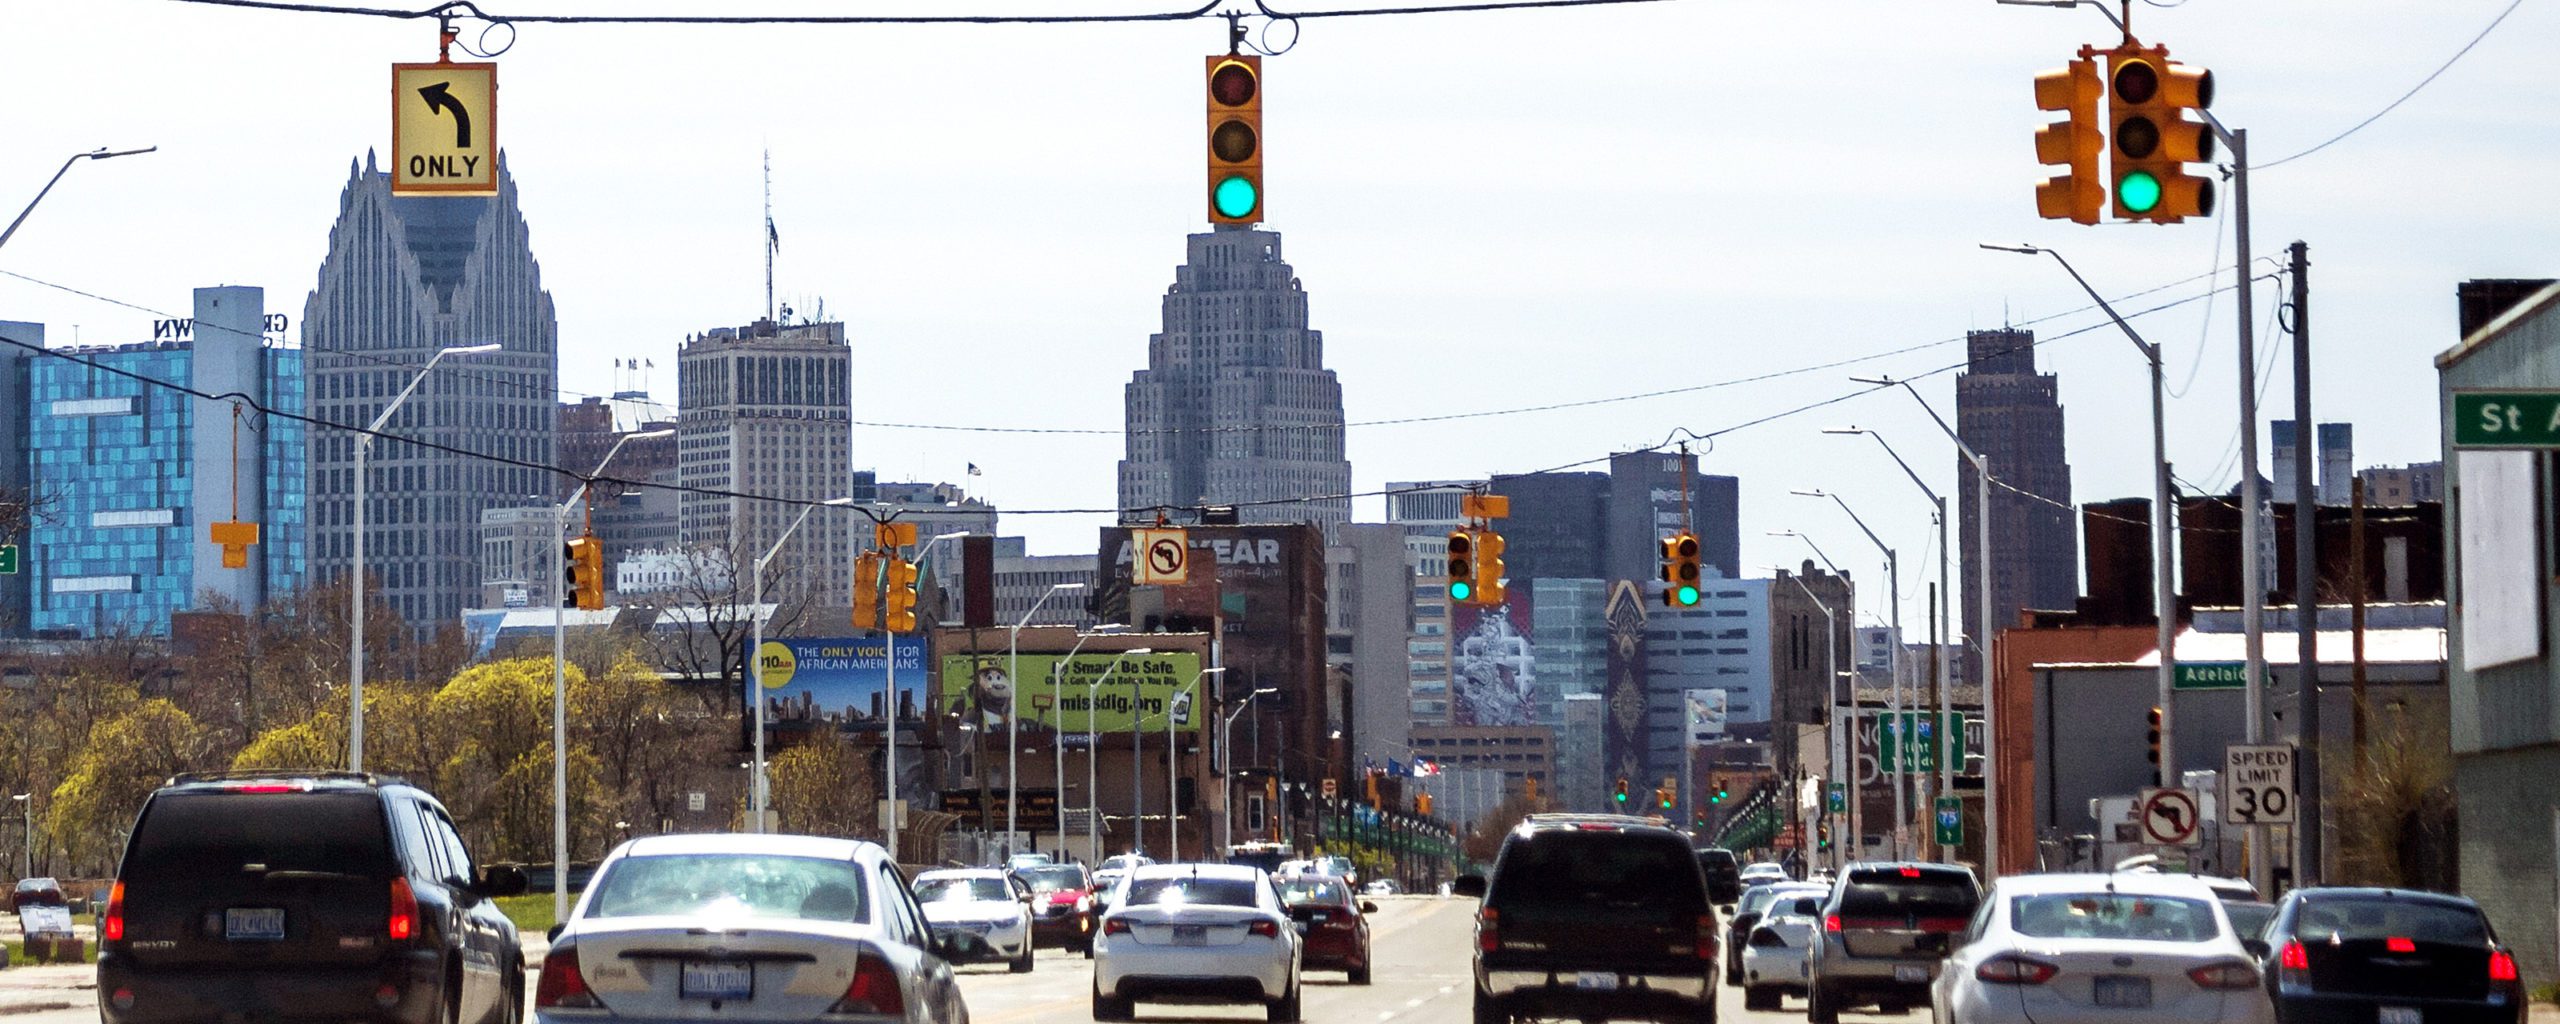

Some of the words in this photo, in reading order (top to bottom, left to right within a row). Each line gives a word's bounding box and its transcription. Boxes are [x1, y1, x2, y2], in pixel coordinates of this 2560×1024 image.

[410, 154, 480, 178] ONLY
[2481, 402, 2521, 432] St
[797, 647, 822, 657] THE
[822, 646, 854, 658] ONLY
[857, 647, 887, 658] VOIC
[896, 647, 919, 657] FOR
[798, 659, 849, 670] AFRICAN
[852, 659, 919, 670] AMERIANS
[1121, 661, 1140, 674] Be
[1143, 661, 1176, 674] Safe.
[2186, 667, 2248, 681] Adelaid
[2231, 752, 2288, 766] SPEED
[2237, 769, 2282, 783] LIMIT
[2234, 786, 2287, 818] 30
[1940, 811, 1957, 823] 75
